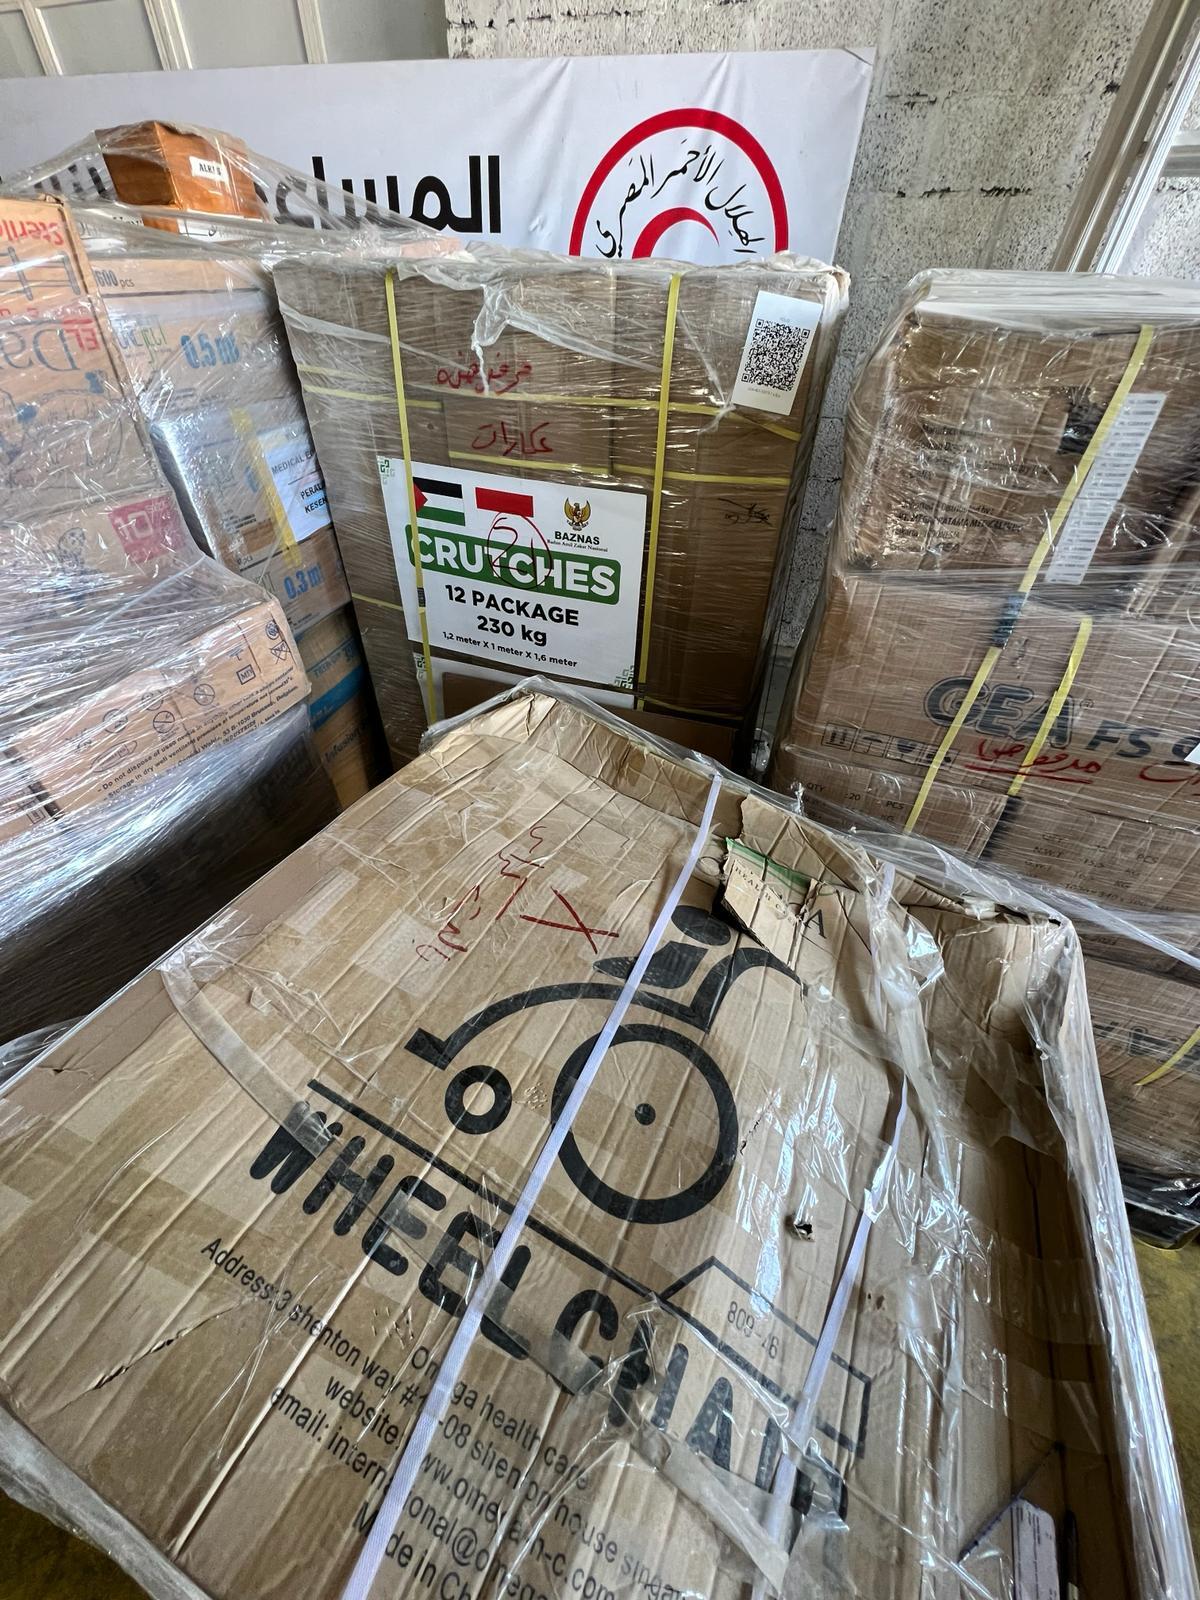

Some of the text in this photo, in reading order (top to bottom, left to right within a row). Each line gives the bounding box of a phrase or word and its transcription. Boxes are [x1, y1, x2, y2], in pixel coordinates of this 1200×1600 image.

[271, 456, 304, 475] MEDICAL
[554, 530, 600, 546] BAZNAS
[410, 533, 617, 598] CRUTCHES
[444, 584, 580, 627] 12 PACKAGE
[442, 631, 455, 642] 1,2
[456, 634, 482, 649] meter
[497, 645, 524, 658] meter
[533, 652, 548, 663] 1,6
[549, 656, 578, 669] meter
[476, 615, 548, 648] 230 kg
[924, 675, 1075, 750] GEA
[1084, 719, 1164, 759] FS
[102, 780, 114, 790] Do
[113, 772, 126, 782] not
[271, 1386, 330, 1442] email:
[288, 1304, 362, 1368] shenton
[361, 1356, 402, 1399] way
[554, 1497, 618, 1563] house
[411, 1345, 589, 1491] Omga health care
[353, 1501, 413, 1568] Mde
[413, 1555, 437, 1589] in
